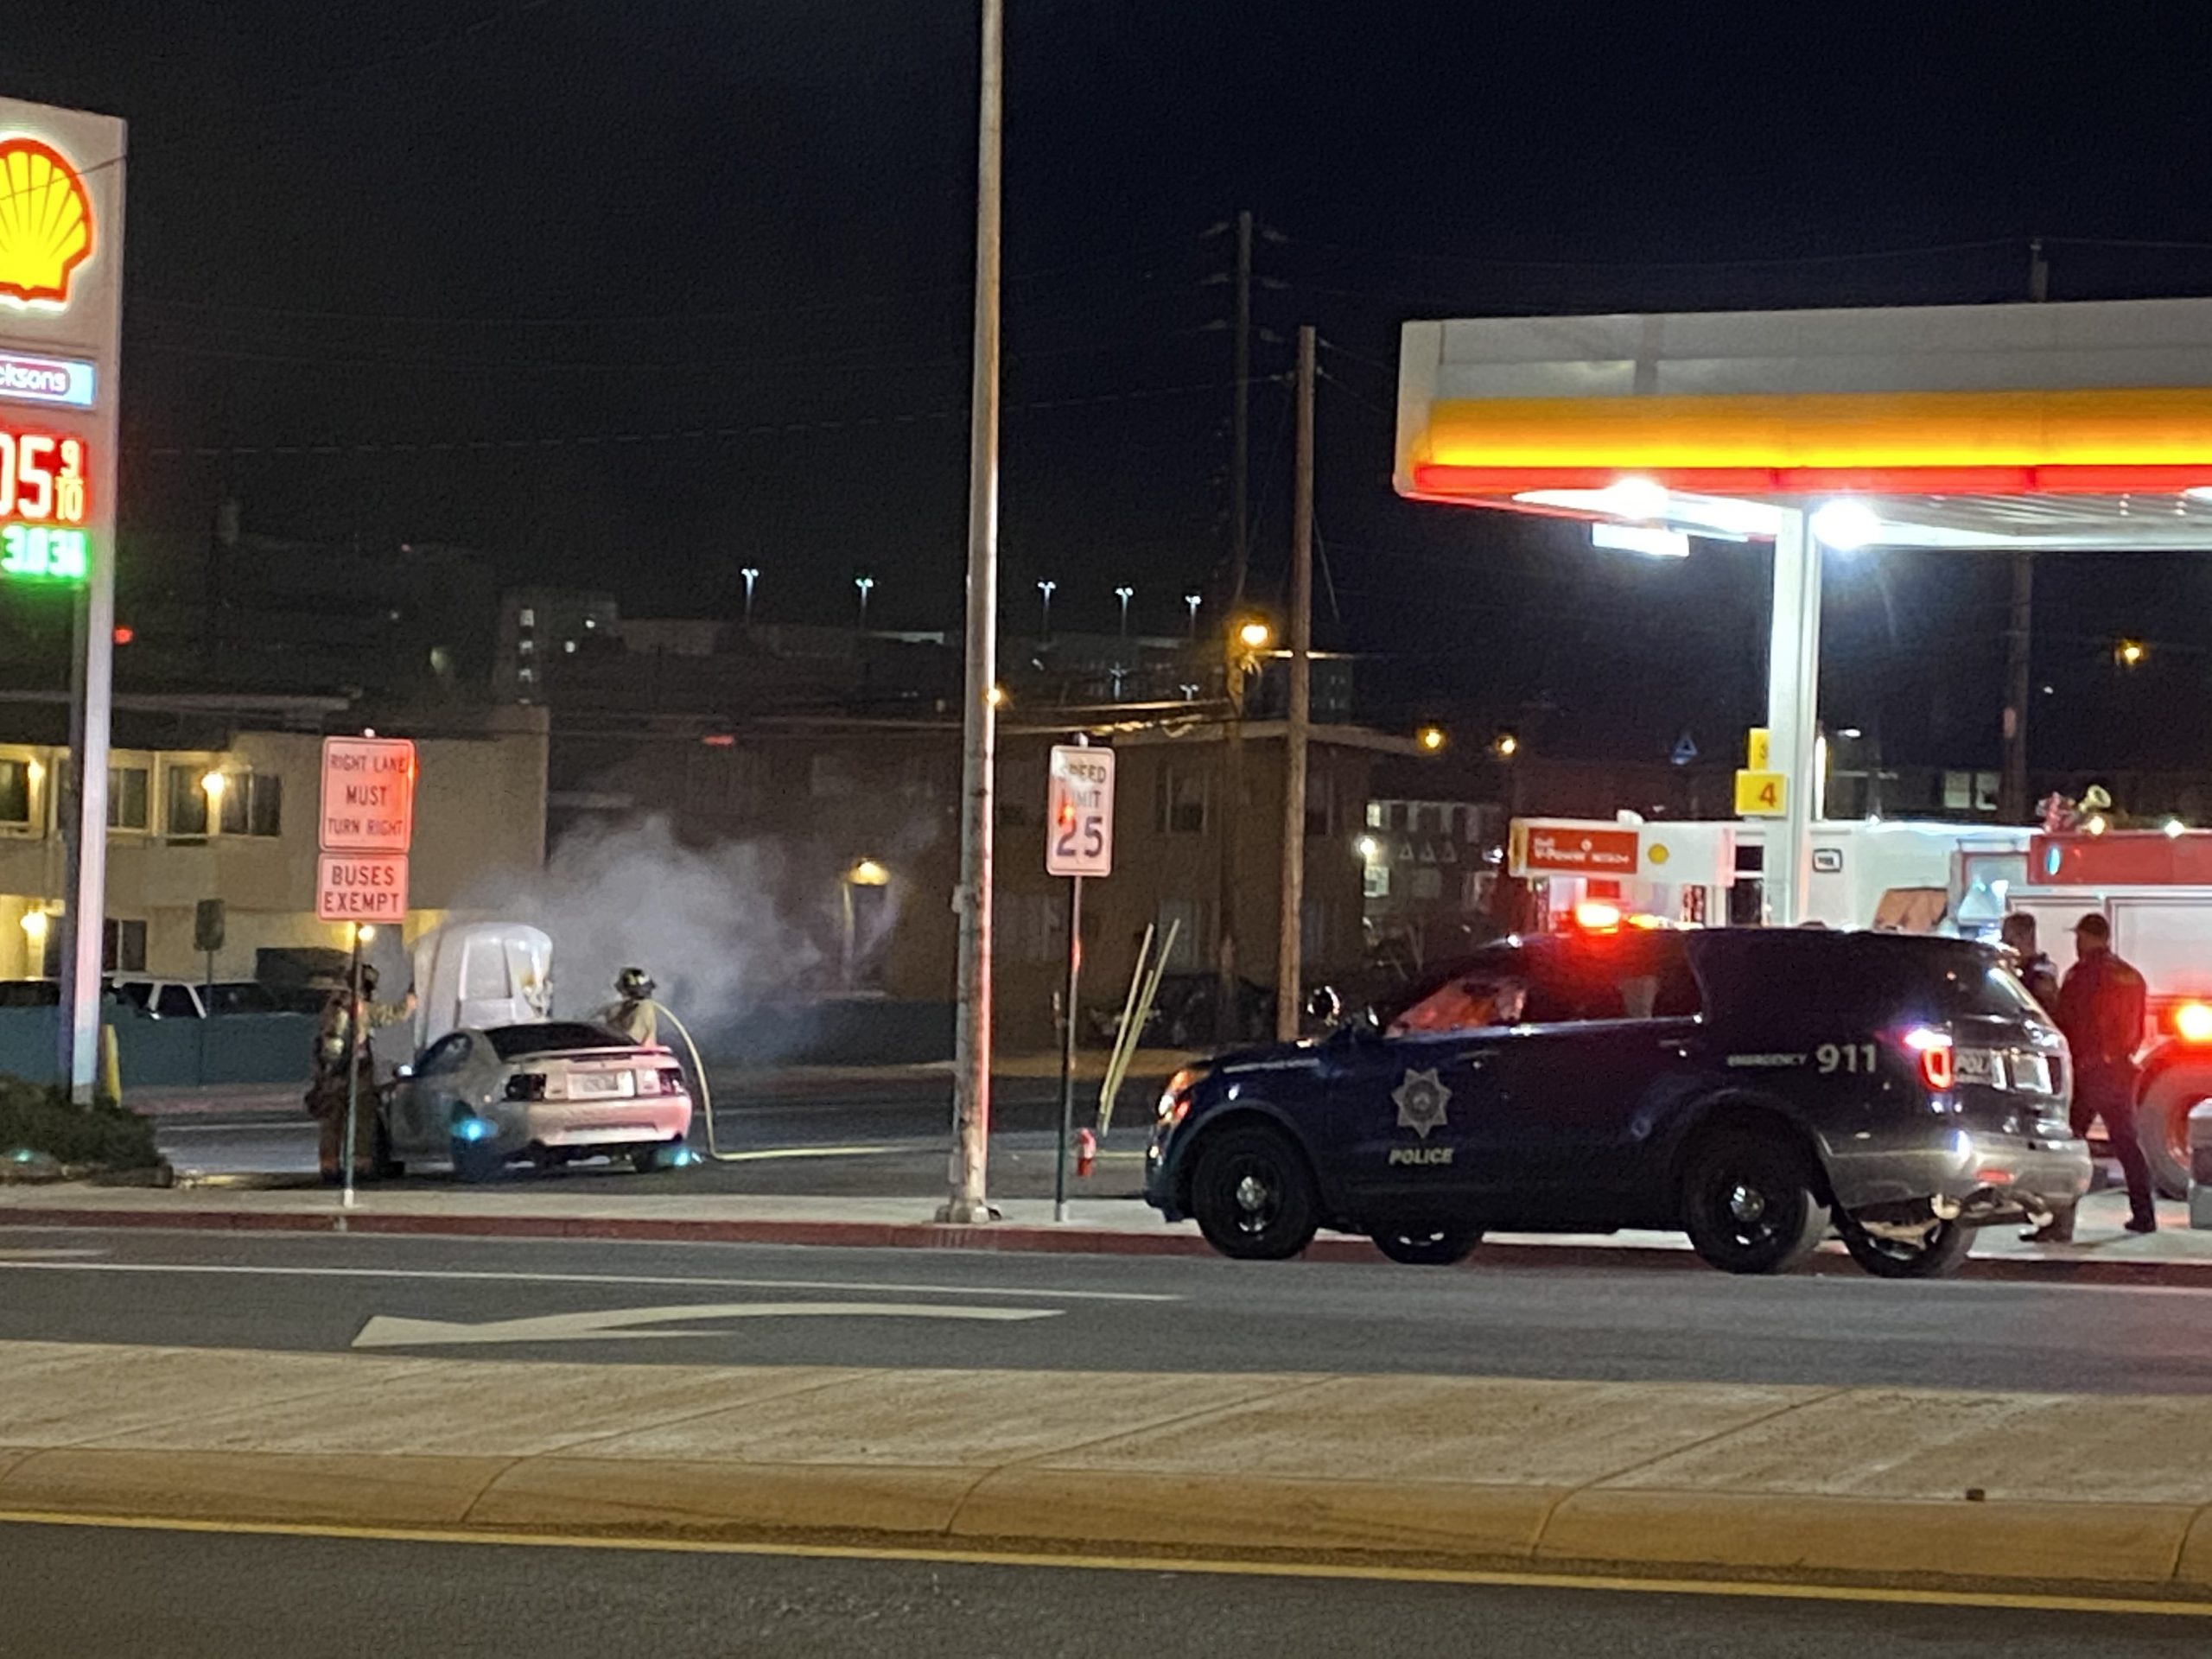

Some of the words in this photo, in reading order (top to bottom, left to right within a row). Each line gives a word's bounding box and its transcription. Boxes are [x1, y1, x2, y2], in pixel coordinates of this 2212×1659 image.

[330, 753, 367, 772] RIGHT
[373, 757, 407, 774] LANE
[346, 785, 387, 806] MUST
[1758, 781, 1777, 808] 4
[328, 817, 360, 835] TURN
[367, 819, 404, 836] RIGHT
[1056, 816, 1103, 858] 25
[332, 866, 395, 887] BUSES
[324, 891, 400, 913] EXEMPT
[1816, 1043, 1876, 1071] 911
[1389, 1147, 1454, 1166] POLICE
